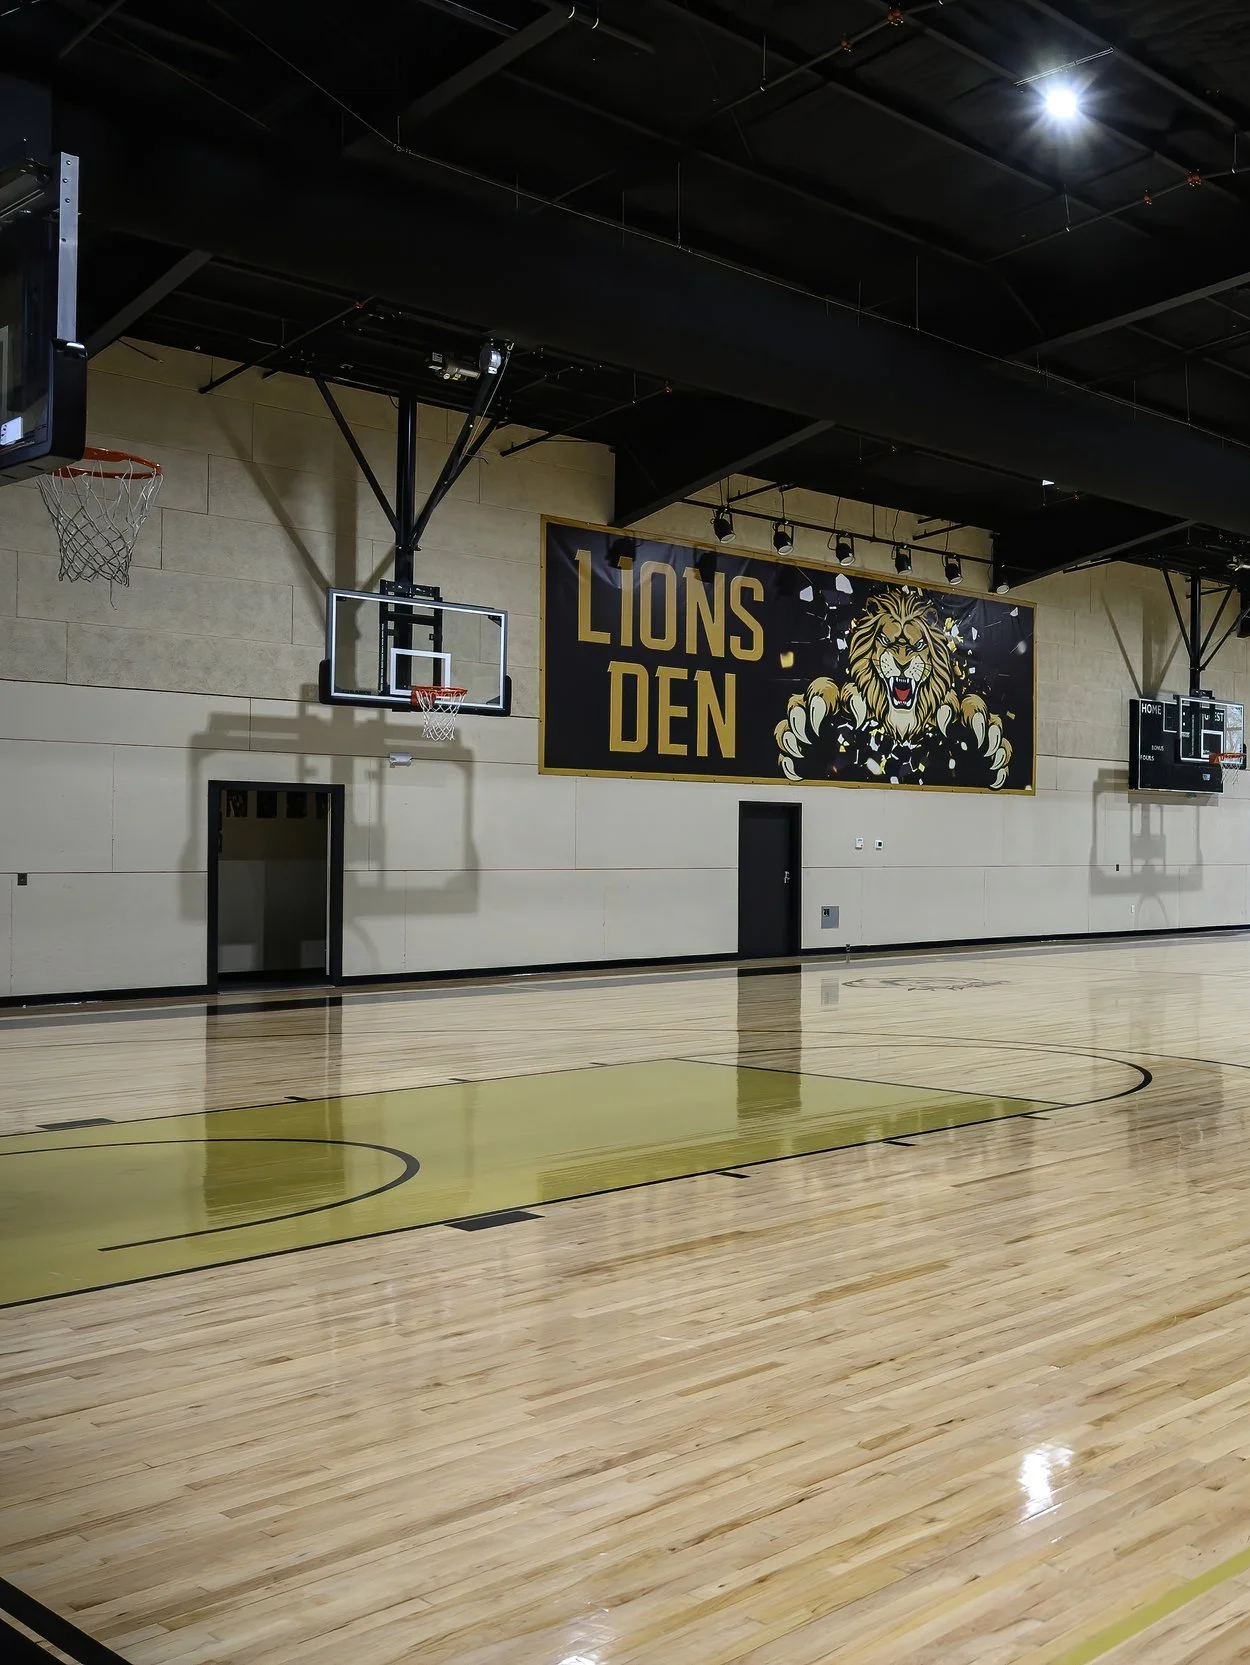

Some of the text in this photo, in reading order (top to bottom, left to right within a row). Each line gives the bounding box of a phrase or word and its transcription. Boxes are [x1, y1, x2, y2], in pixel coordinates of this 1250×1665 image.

[574, 549, 765, 662] LIONS
[606, 660, 736, 758] DEN
[1141, 703, 1162, 715] HOME
